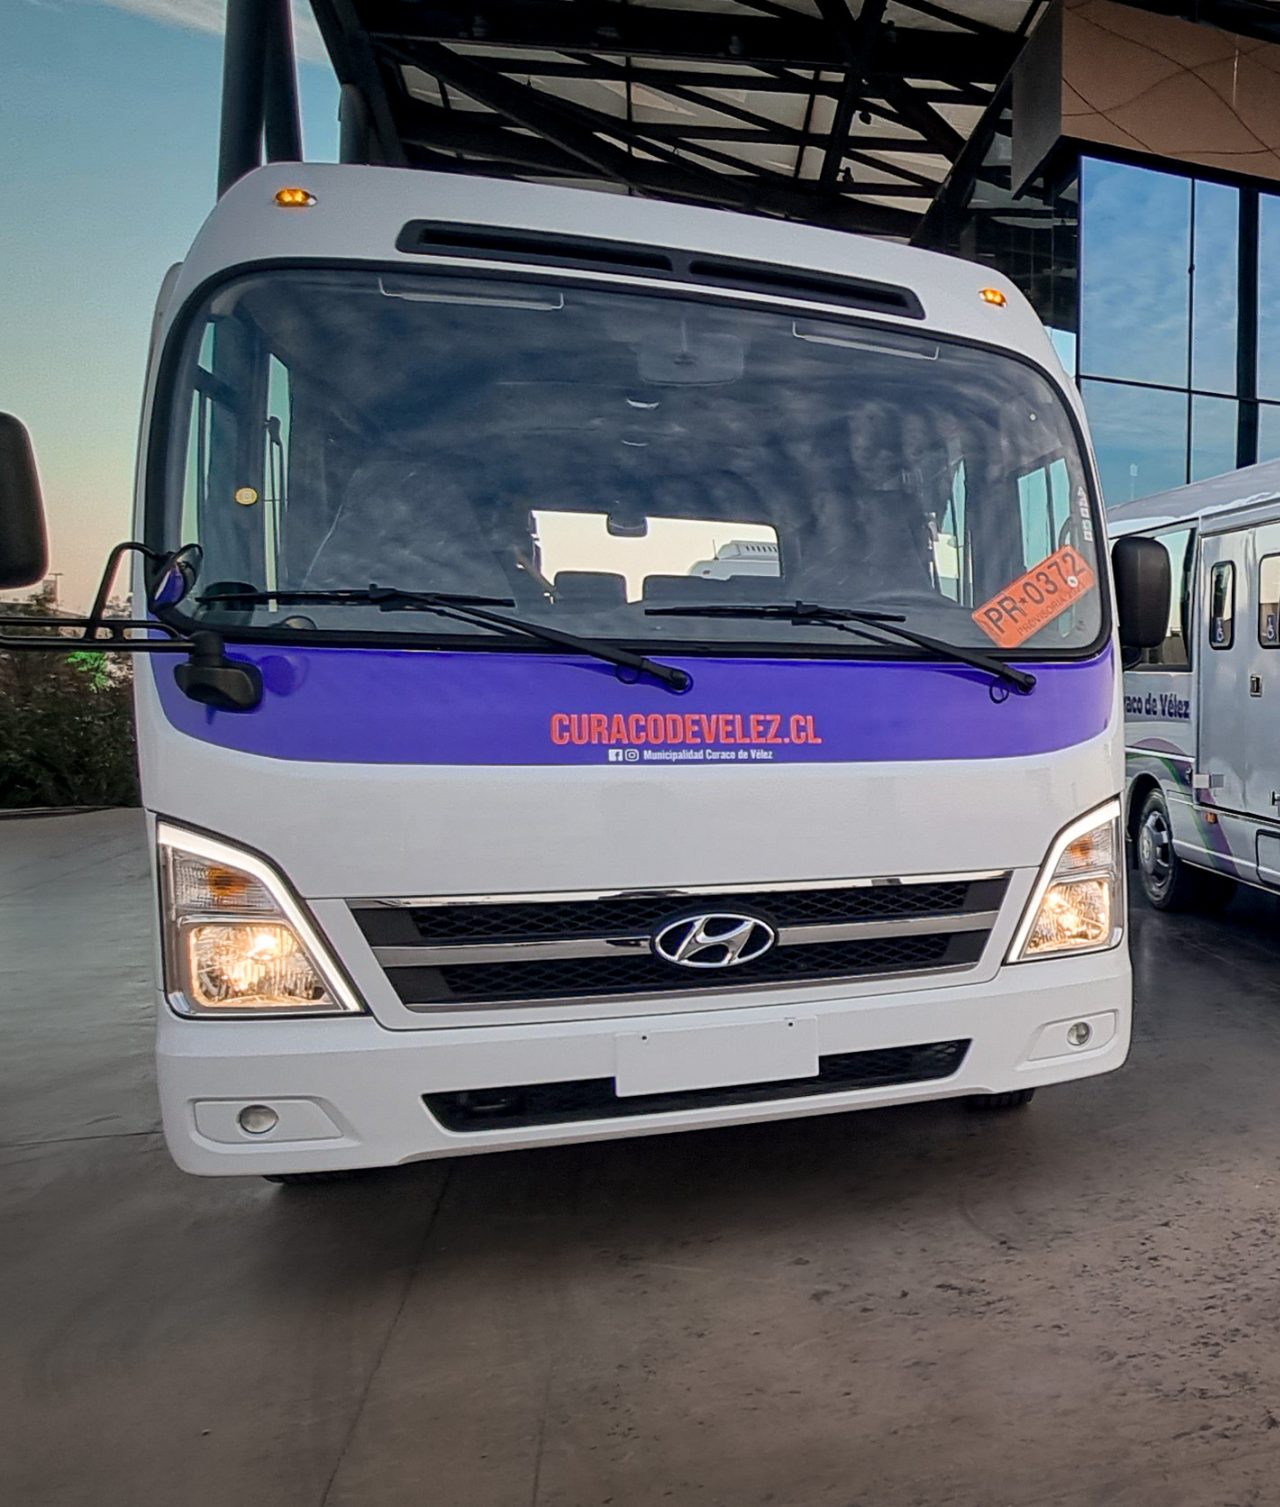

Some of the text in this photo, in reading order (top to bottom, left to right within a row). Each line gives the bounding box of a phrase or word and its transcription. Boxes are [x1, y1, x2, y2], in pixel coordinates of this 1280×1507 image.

[1145, 692, 1157, 716] de
[1160, 692, 1190, 719] Vélez
[551, 712, 823, 745] CURACODEVELEZ.CL
[643, 748, 773, 762] Municipalidad Curaco de Vélez
